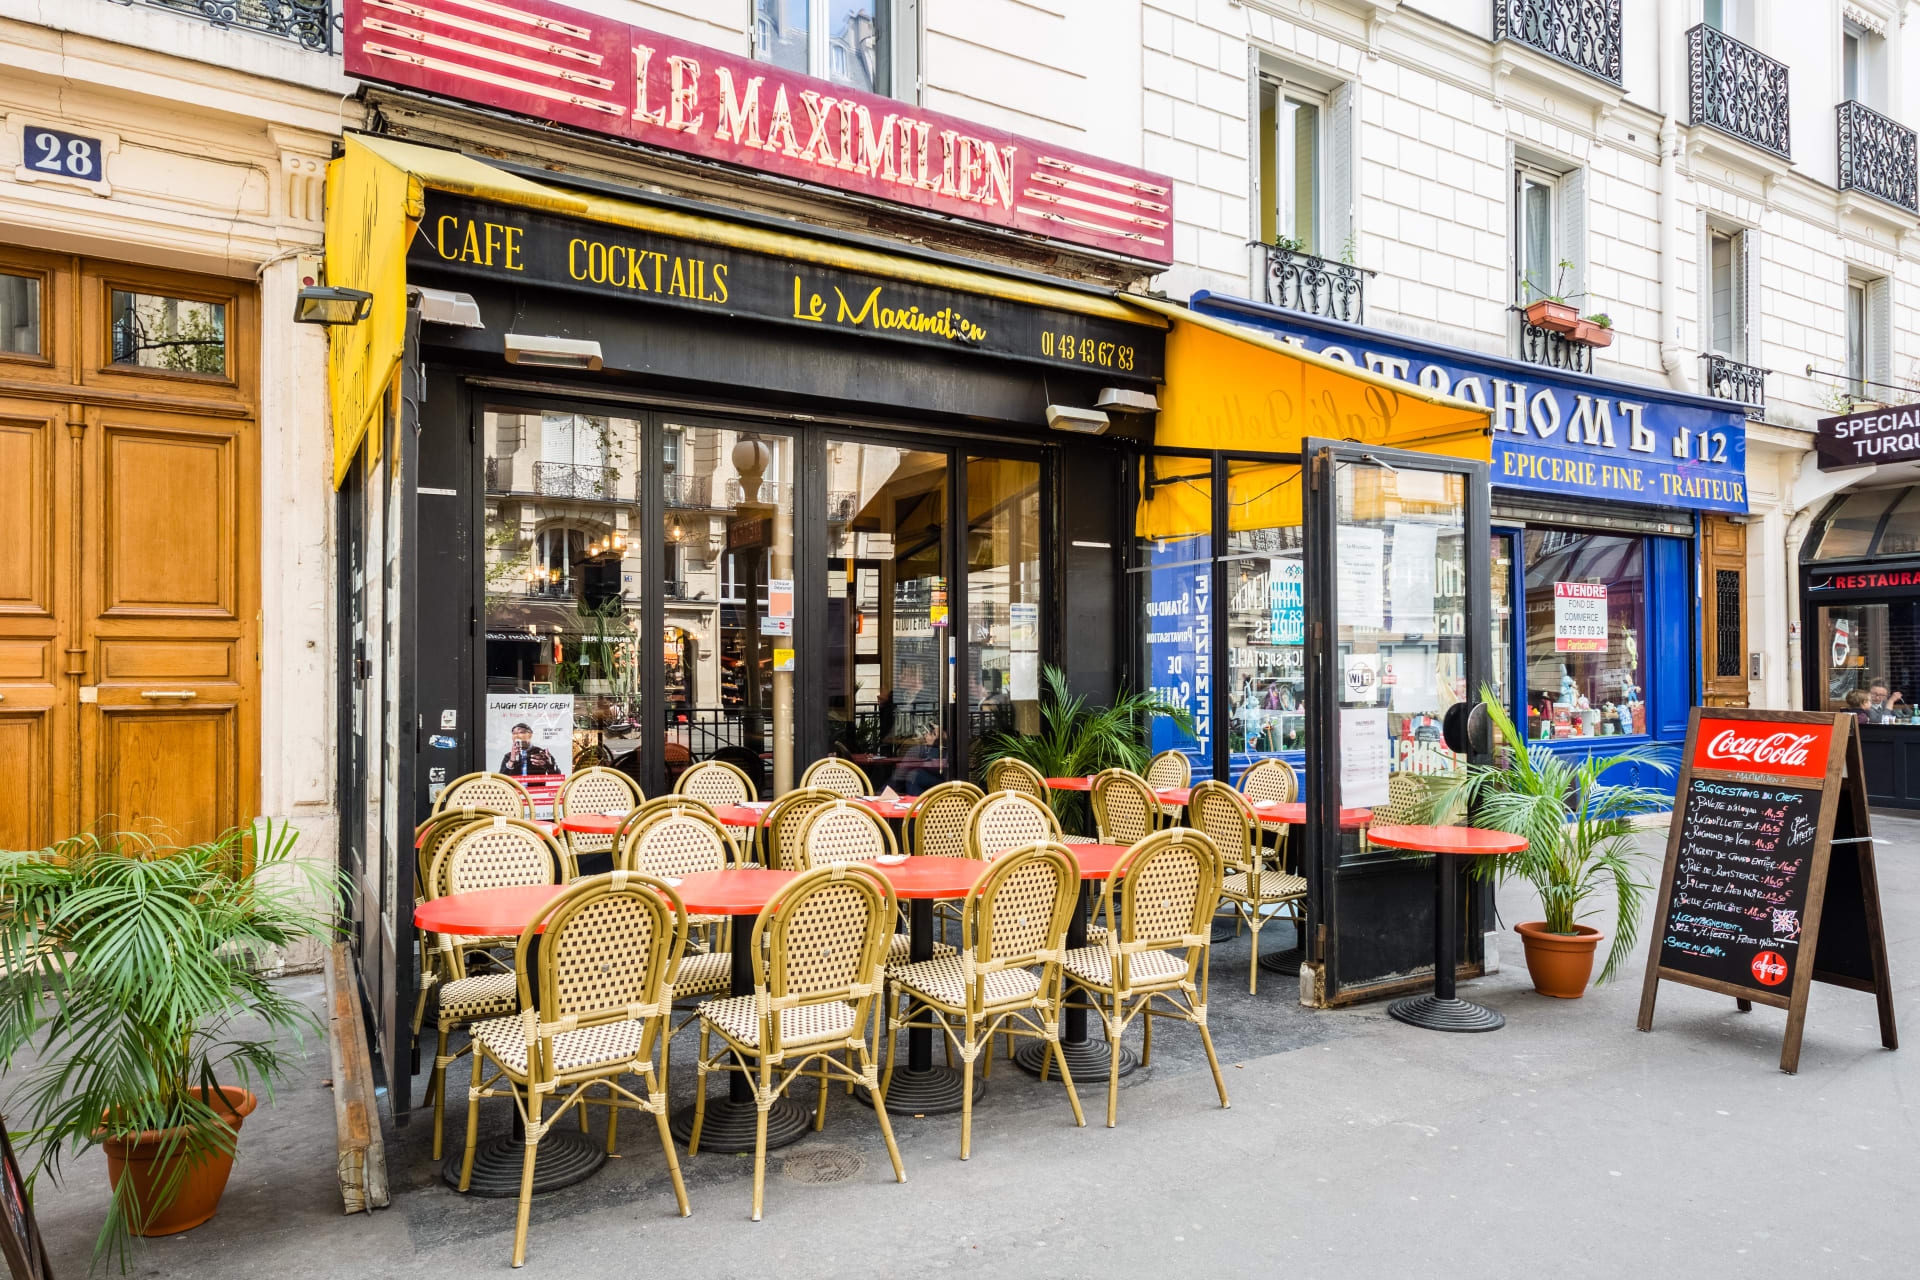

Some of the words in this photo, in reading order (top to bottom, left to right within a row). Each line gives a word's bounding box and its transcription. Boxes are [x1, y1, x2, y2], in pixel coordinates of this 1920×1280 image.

[631, 44, 704, 134] LE
[715, 66, 1018, 210] MAXIMILIEN
[34, 132, 95, 176] 28
[437, 215, 524, 272] CAFE
[569, 237, 728, 304] COCKTAILS
[793, 276, 826, 321] Le
[835, 285, 986, 343] Maximilien
[1041, 331, 1055, 356] 01
[1058, 334, 1074, 360] 43
[1078, 337, 1094, 364] 43
[1098, 341, 1115, 368] 67
[1118, 345, 1134, 371] 83
[1835, 409, 1920, 439] SPECIAL
[1697, 430, 1727, 463] 12
[1503, 451, 1597, 487] EPICERIE
[1602, 464, 1643, 492] FINE
[1660, 472, 1745, 504] TRAITEUR
[1557, 583, 1565, 596] A
[1566, 584, 1606, 598] VENDRE
[1836, 571, 1920, 589] RESTAURA
[1564, 613, 1599, 622] COMMERCE
[1569, 599, 1585, 608] FOND
[1586, 600, 1595, 608] DE
[1560, 625, 1568, 634] 06
[1569, 625, 1577, 634] 75
[1578, 625, 1586, 634] 97
[1596, 626, 1604, 635] 24
[1567, 640, 1598, 650] Particulier
[490, 702, 517, 710] LAUGH
[520, 702, 548, 710] STEADY
[1707, 729, 1818, 766] Coca-Cola
